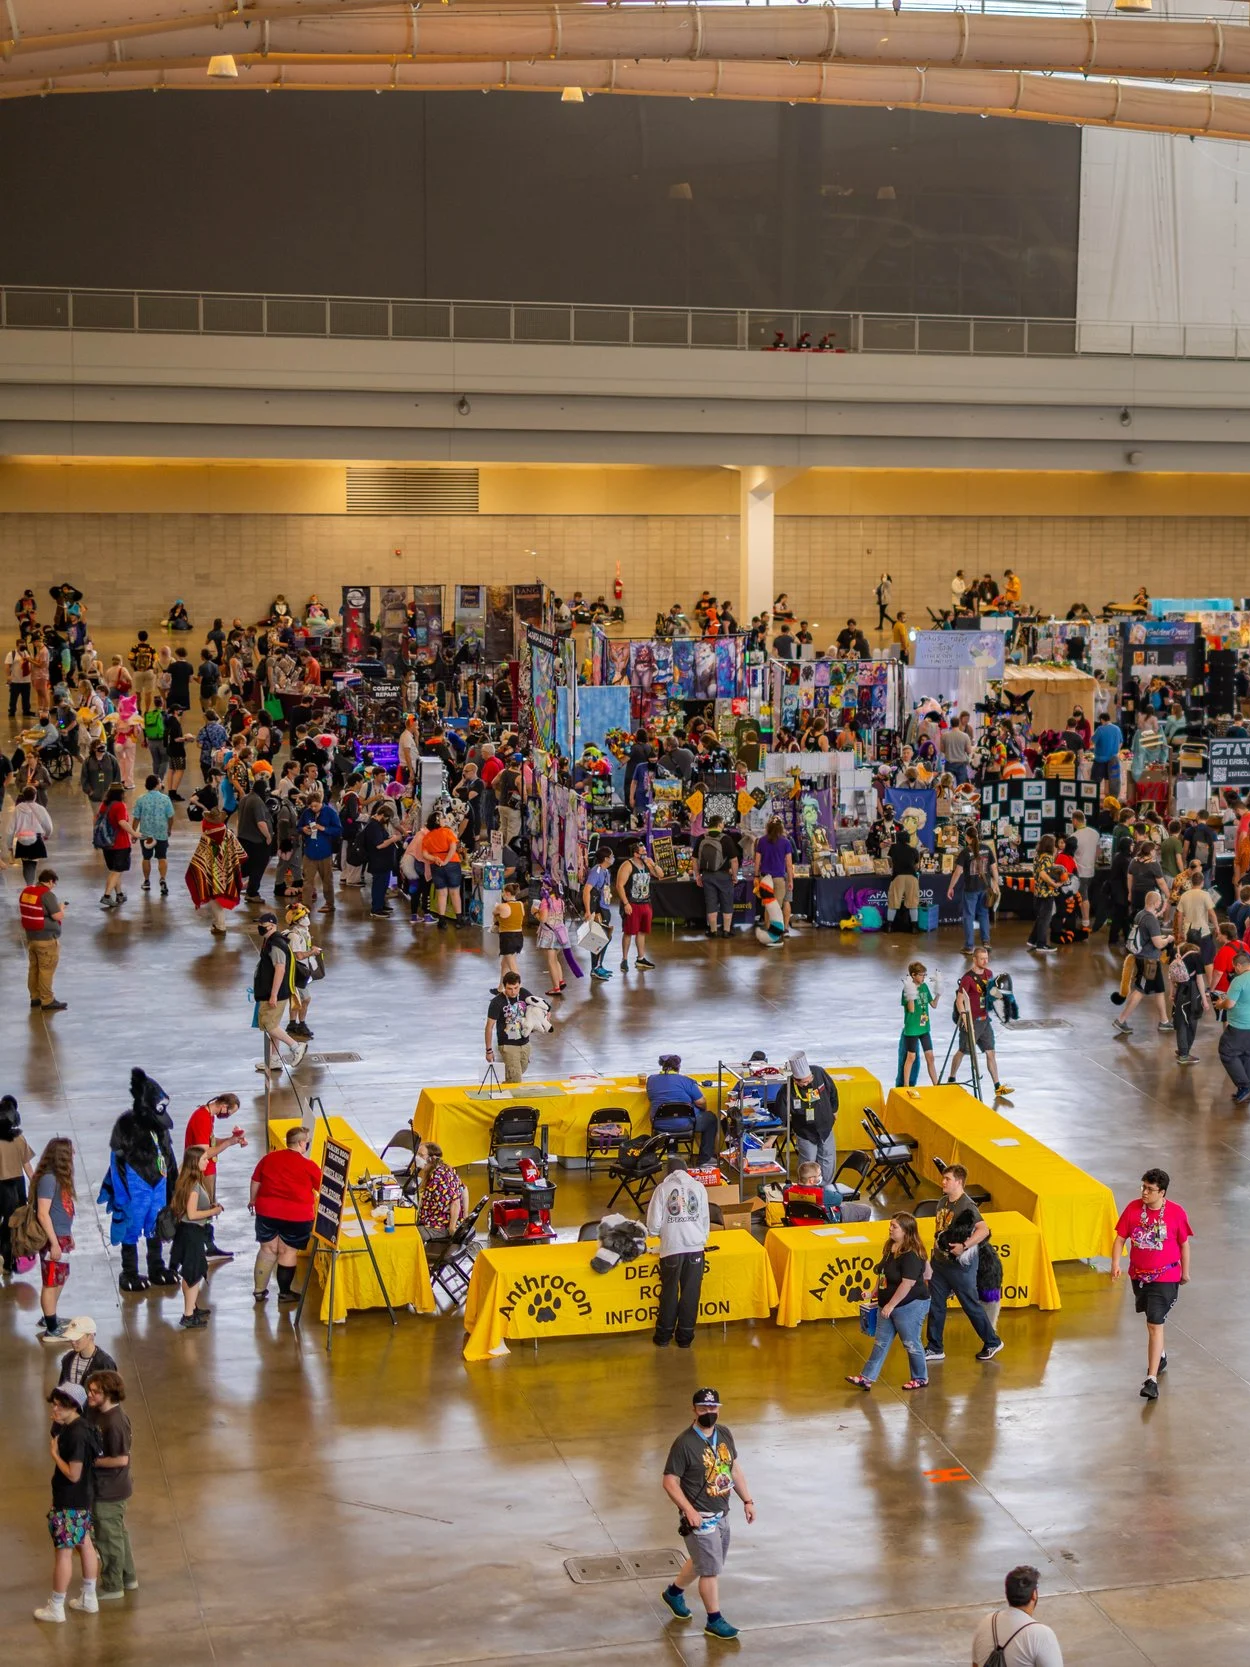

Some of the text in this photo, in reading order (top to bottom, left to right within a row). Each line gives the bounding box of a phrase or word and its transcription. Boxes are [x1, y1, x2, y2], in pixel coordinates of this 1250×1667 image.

[625, 1260, 711, 1281] DEAS
[809, 1256, 880, 1302] Anthro
[499, 1274, 592, 1322] Anthrocon
[605, 1301, 730, 1325] INFORION
